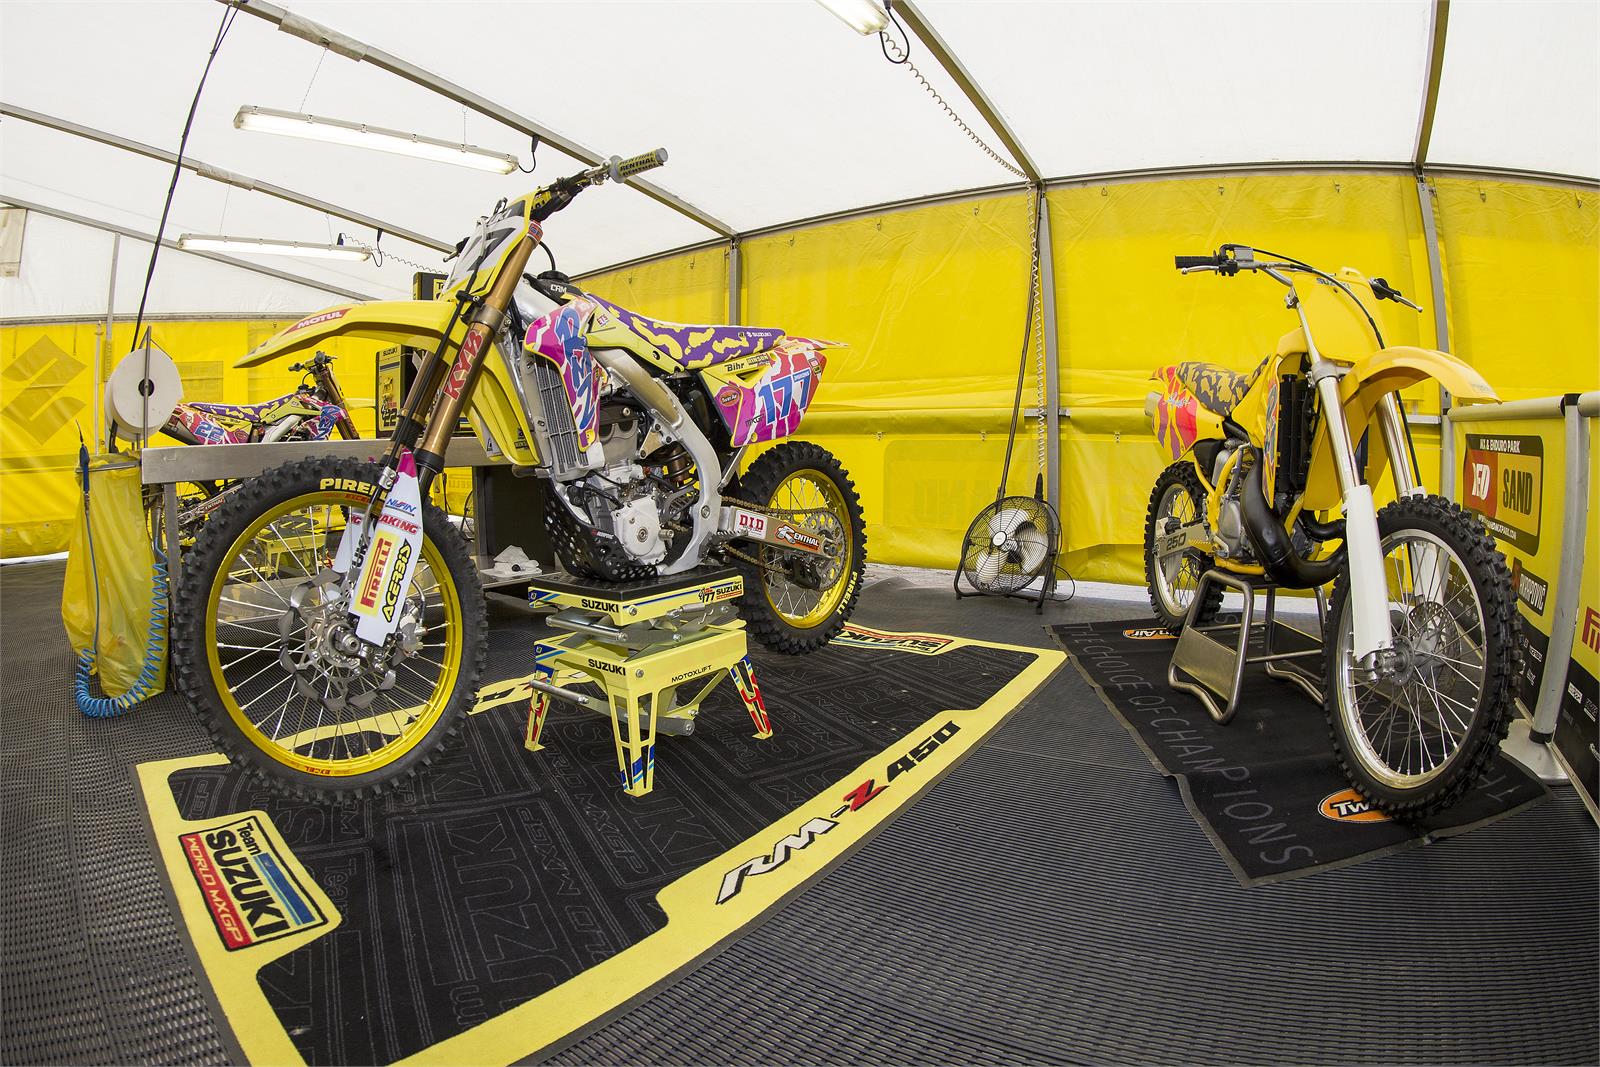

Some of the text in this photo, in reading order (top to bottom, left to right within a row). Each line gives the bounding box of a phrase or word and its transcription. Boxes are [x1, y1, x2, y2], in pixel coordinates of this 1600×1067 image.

[620, 157, 656, 171] RENTHAL
[297, 311, 343, 329] MOTUL
[443, 329, 484, 401] KYB
[725, 362, 745, 372] Bihr
[758, 369, 811, 426] 177
[194, 420, 225, 442] 22
[1503, 468, 1533, 516] SAND
[1166, 533, 1187, 551] 250
[360, 537, 392, 609] PIRELLI
[381, 538, 412, 622] ACERBIS
[716, 584, 743, 595] SUZUKI
[581, 598, 620, 614] SUZUKI
[836, 571, 858, 615] PIRELLI
[587, 658, 627, 677] SUZUKI
[671, 664, 712, 684] MOTOXLIFT
[1082, 644, 1154, 692] CHOICE
[1128, 695, 1178, 715] OF
[886, 720, 962, 782] 450
[1151, 717, 1314, 865] CHAMPIONS
[237, 822, 262, 856] Team
[187, 837, 214, 886] WORLD
[209, 888, 244, 943] MXGP
[205, 829, 291, 938] SUZUKI
